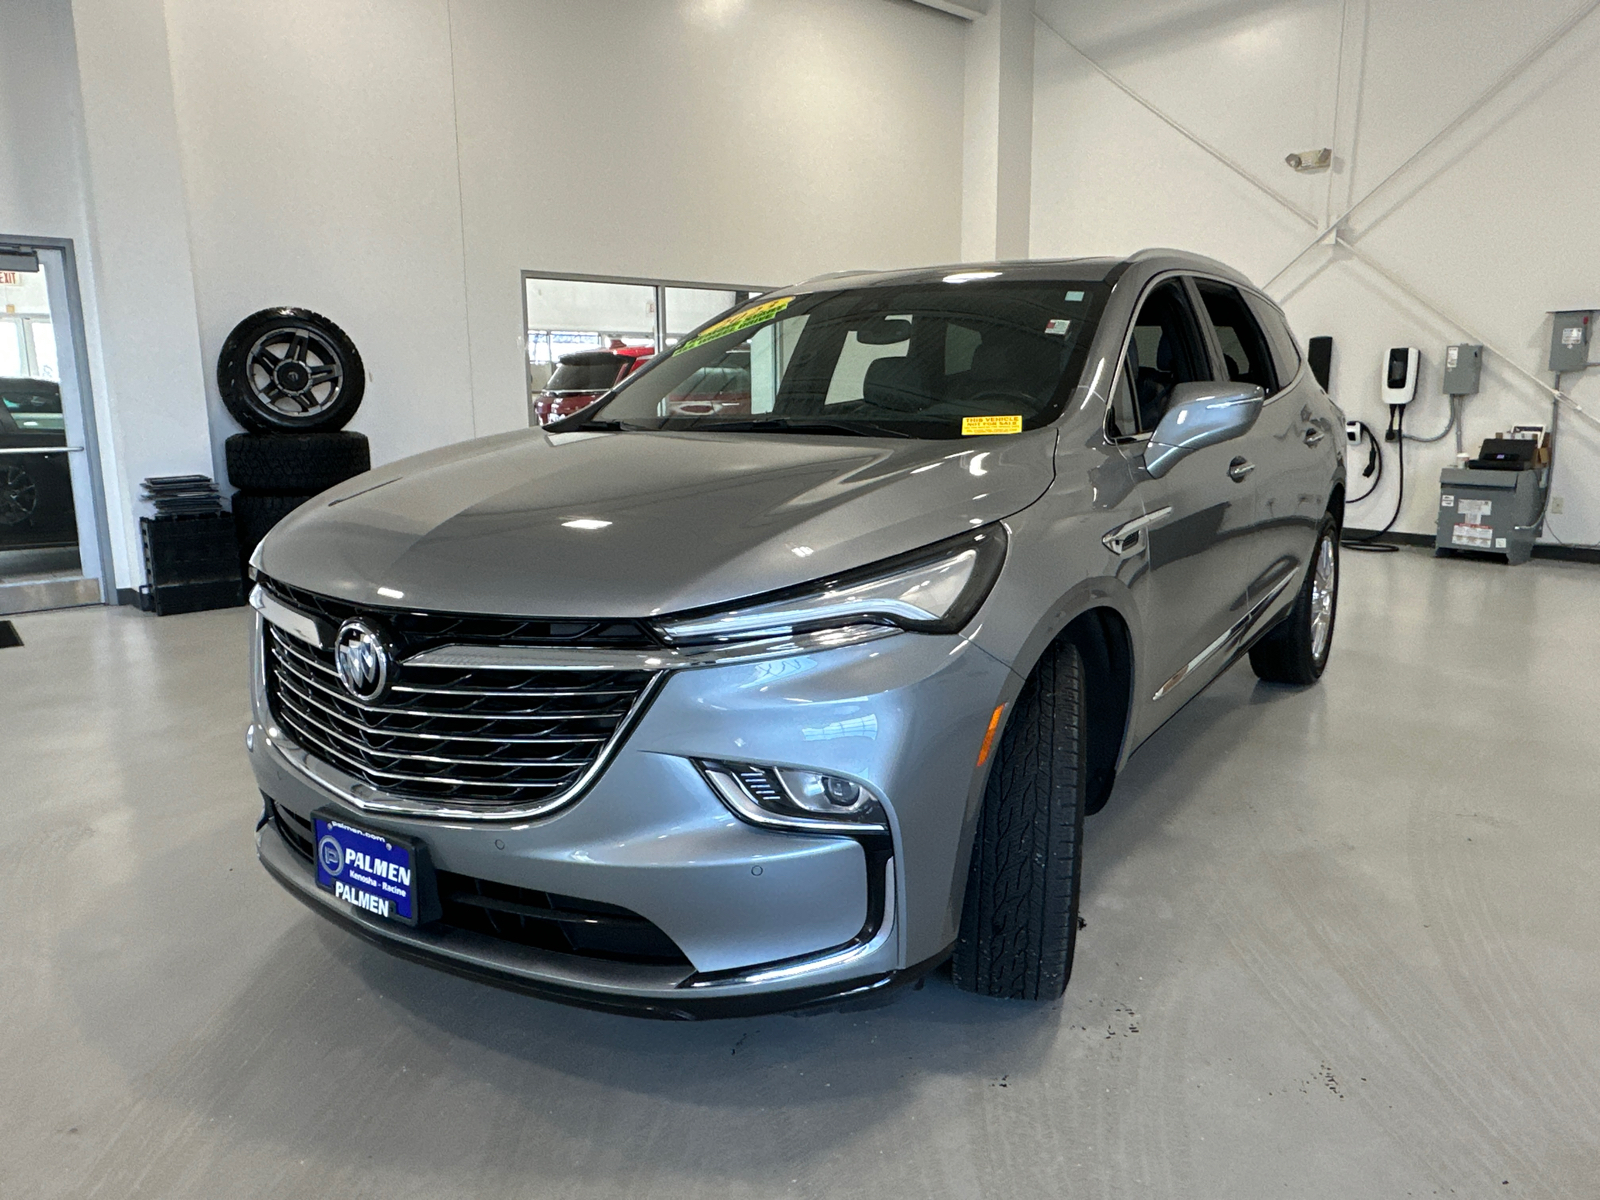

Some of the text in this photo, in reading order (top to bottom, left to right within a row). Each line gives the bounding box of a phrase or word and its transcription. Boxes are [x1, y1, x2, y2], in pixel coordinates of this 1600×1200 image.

[0, 271, 16, 284] EXIT
[345, 848, 411, 886] PALMEN
[335, 881, 389, 917] PALMEN
[349, 869, 377, 887] Kenosha
[382, 881, 407, 898] Racine
